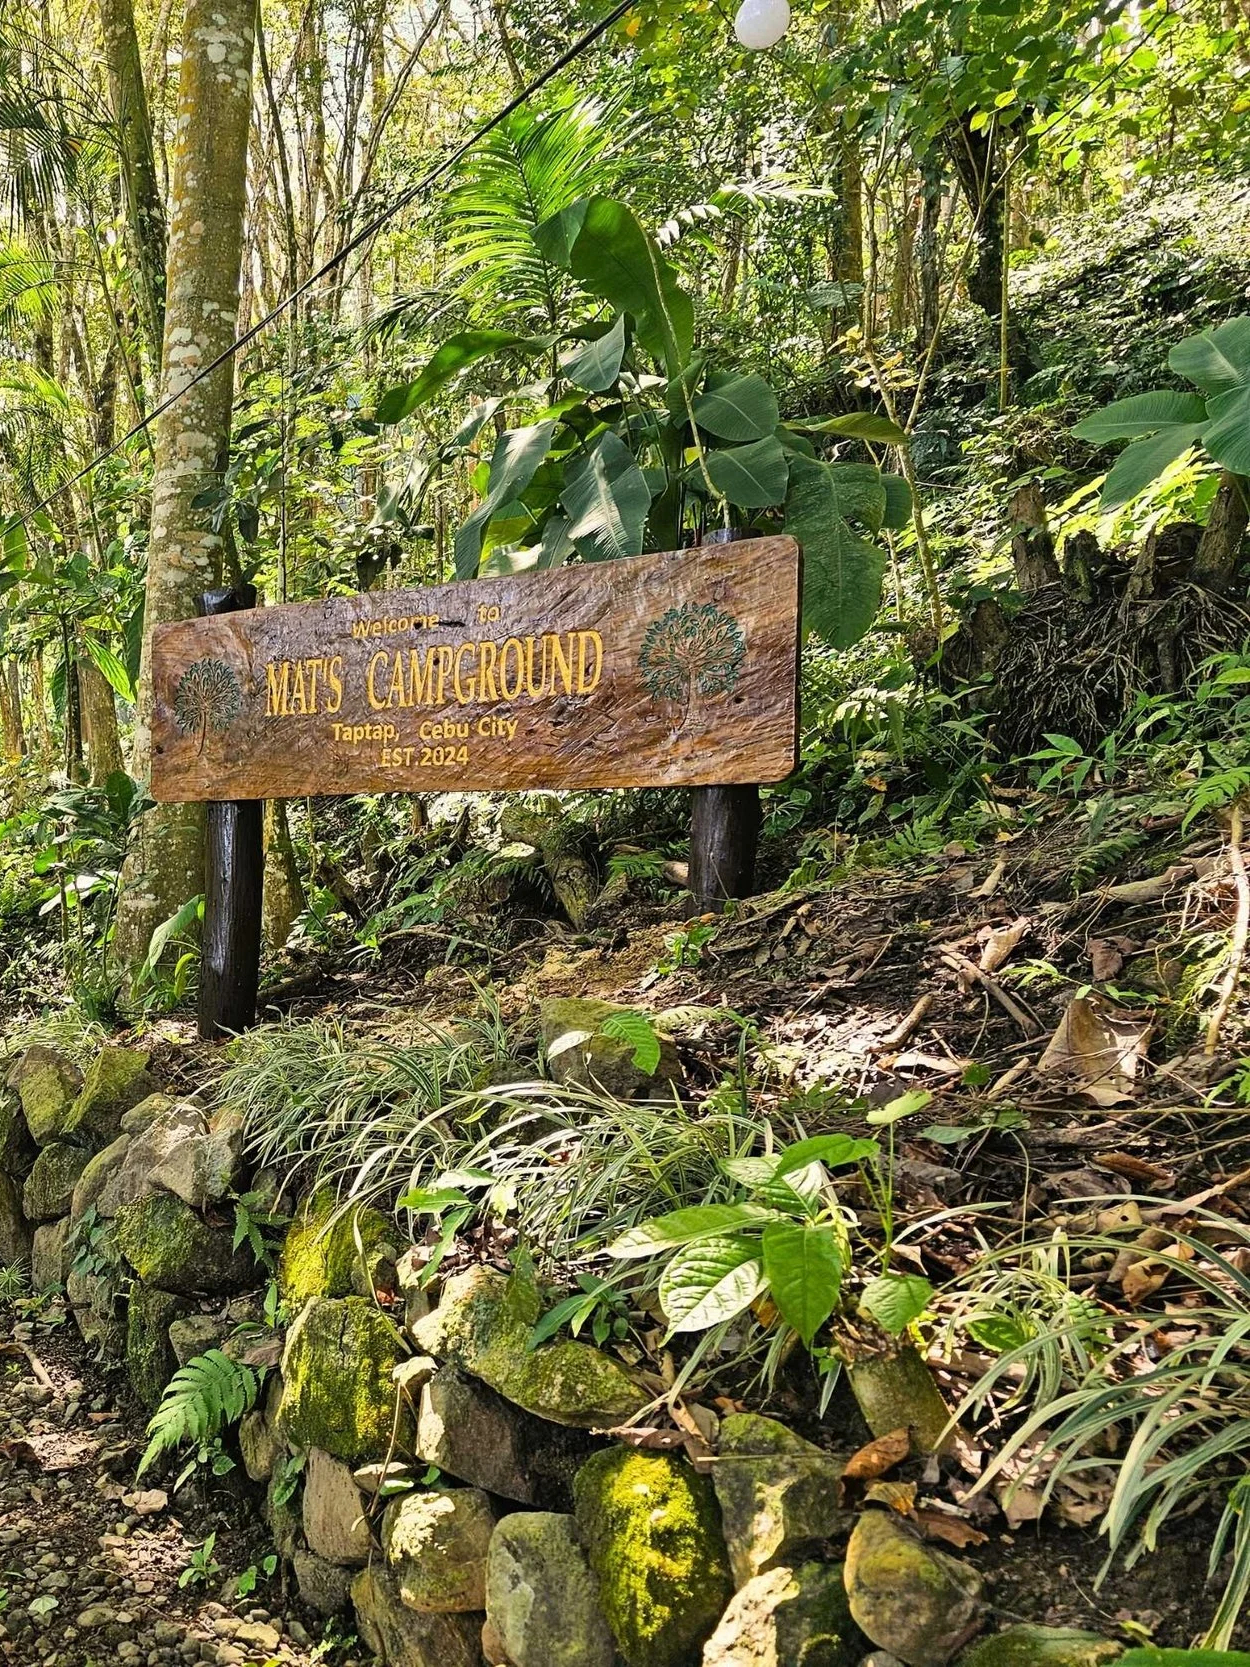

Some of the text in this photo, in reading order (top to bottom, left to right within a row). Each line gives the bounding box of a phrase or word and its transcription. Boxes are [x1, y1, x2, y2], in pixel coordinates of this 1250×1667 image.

[352, 603, 500, 638] Welcome to
[265, 630, 603, 716] MAT'S CAMPGROUND
[331, 716, 519, 744] Taptap, Cebu City
